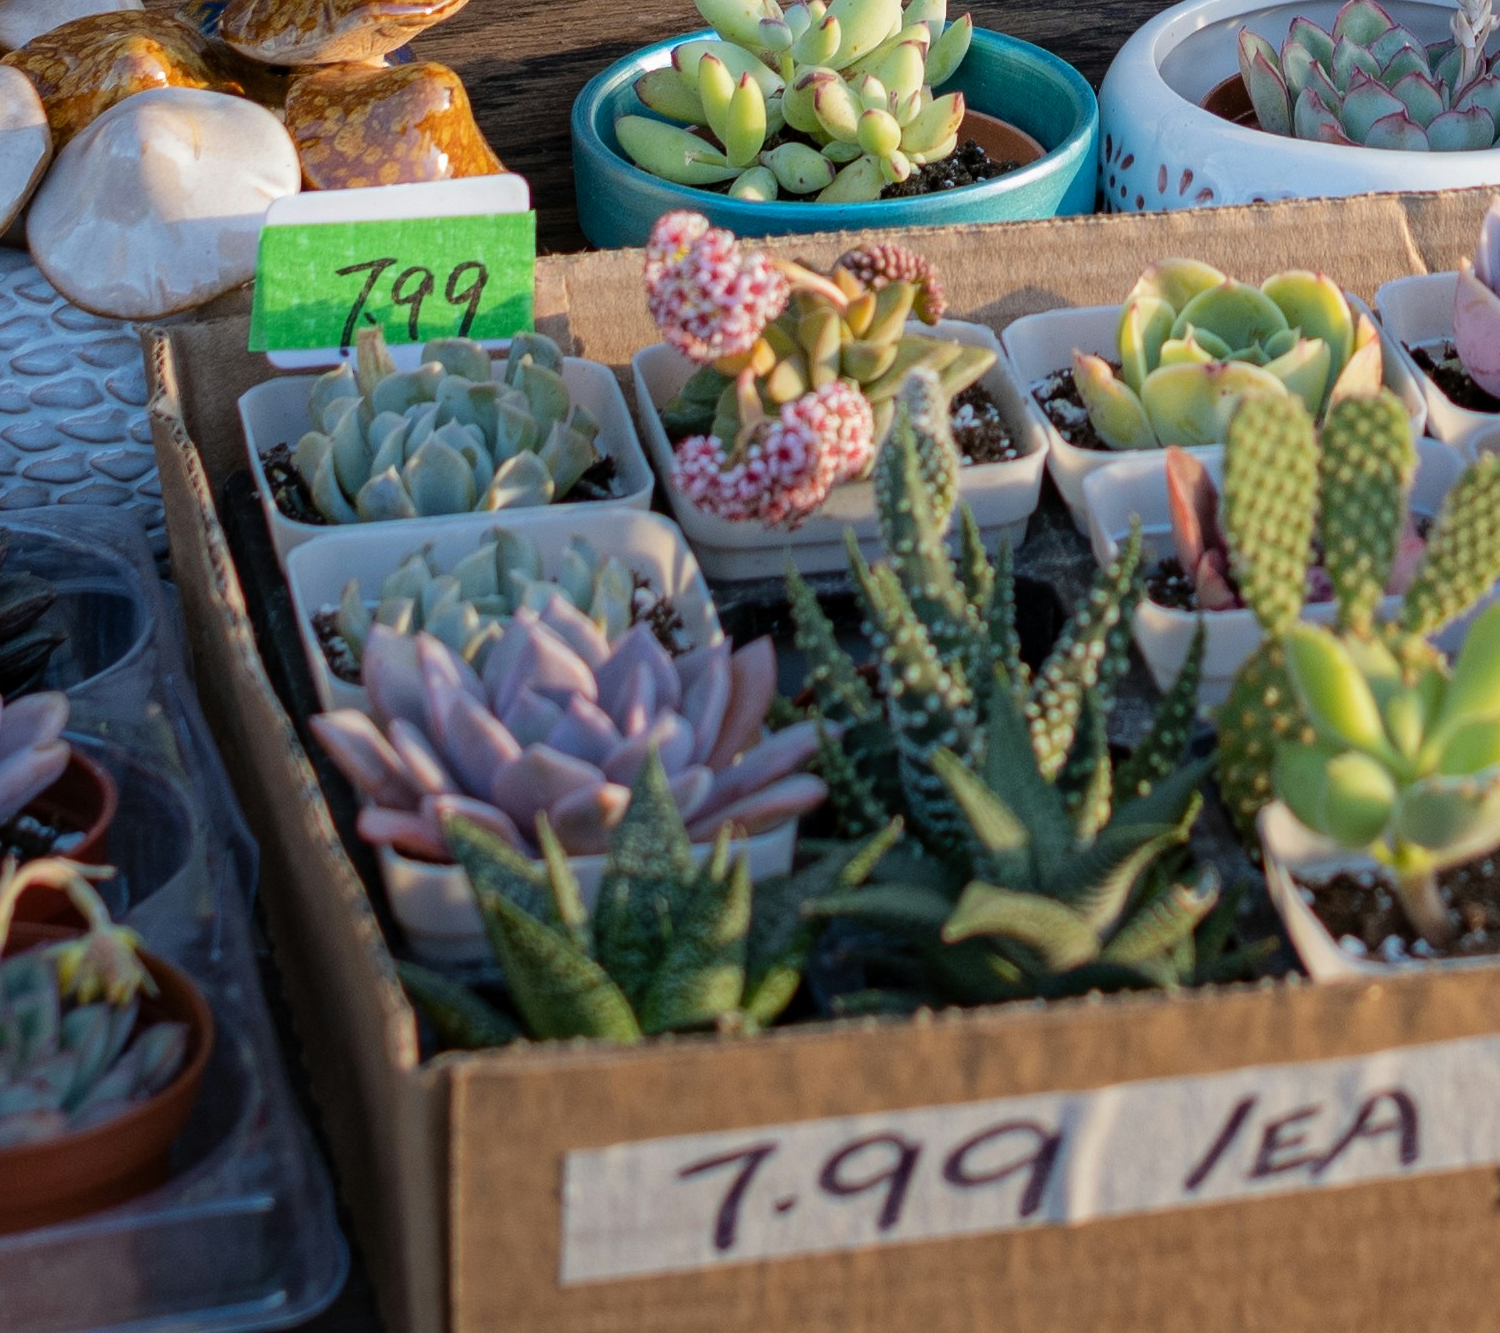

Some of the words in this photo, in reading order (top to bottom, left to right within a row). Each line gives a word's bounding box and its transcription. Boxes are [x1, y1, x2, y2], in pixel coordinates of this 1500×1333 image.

[335, 257, 489, 357] 7.99
[676, 1117, 1064, 1251] 7.99
[1183, 1087, 1421, 1192] /EA
